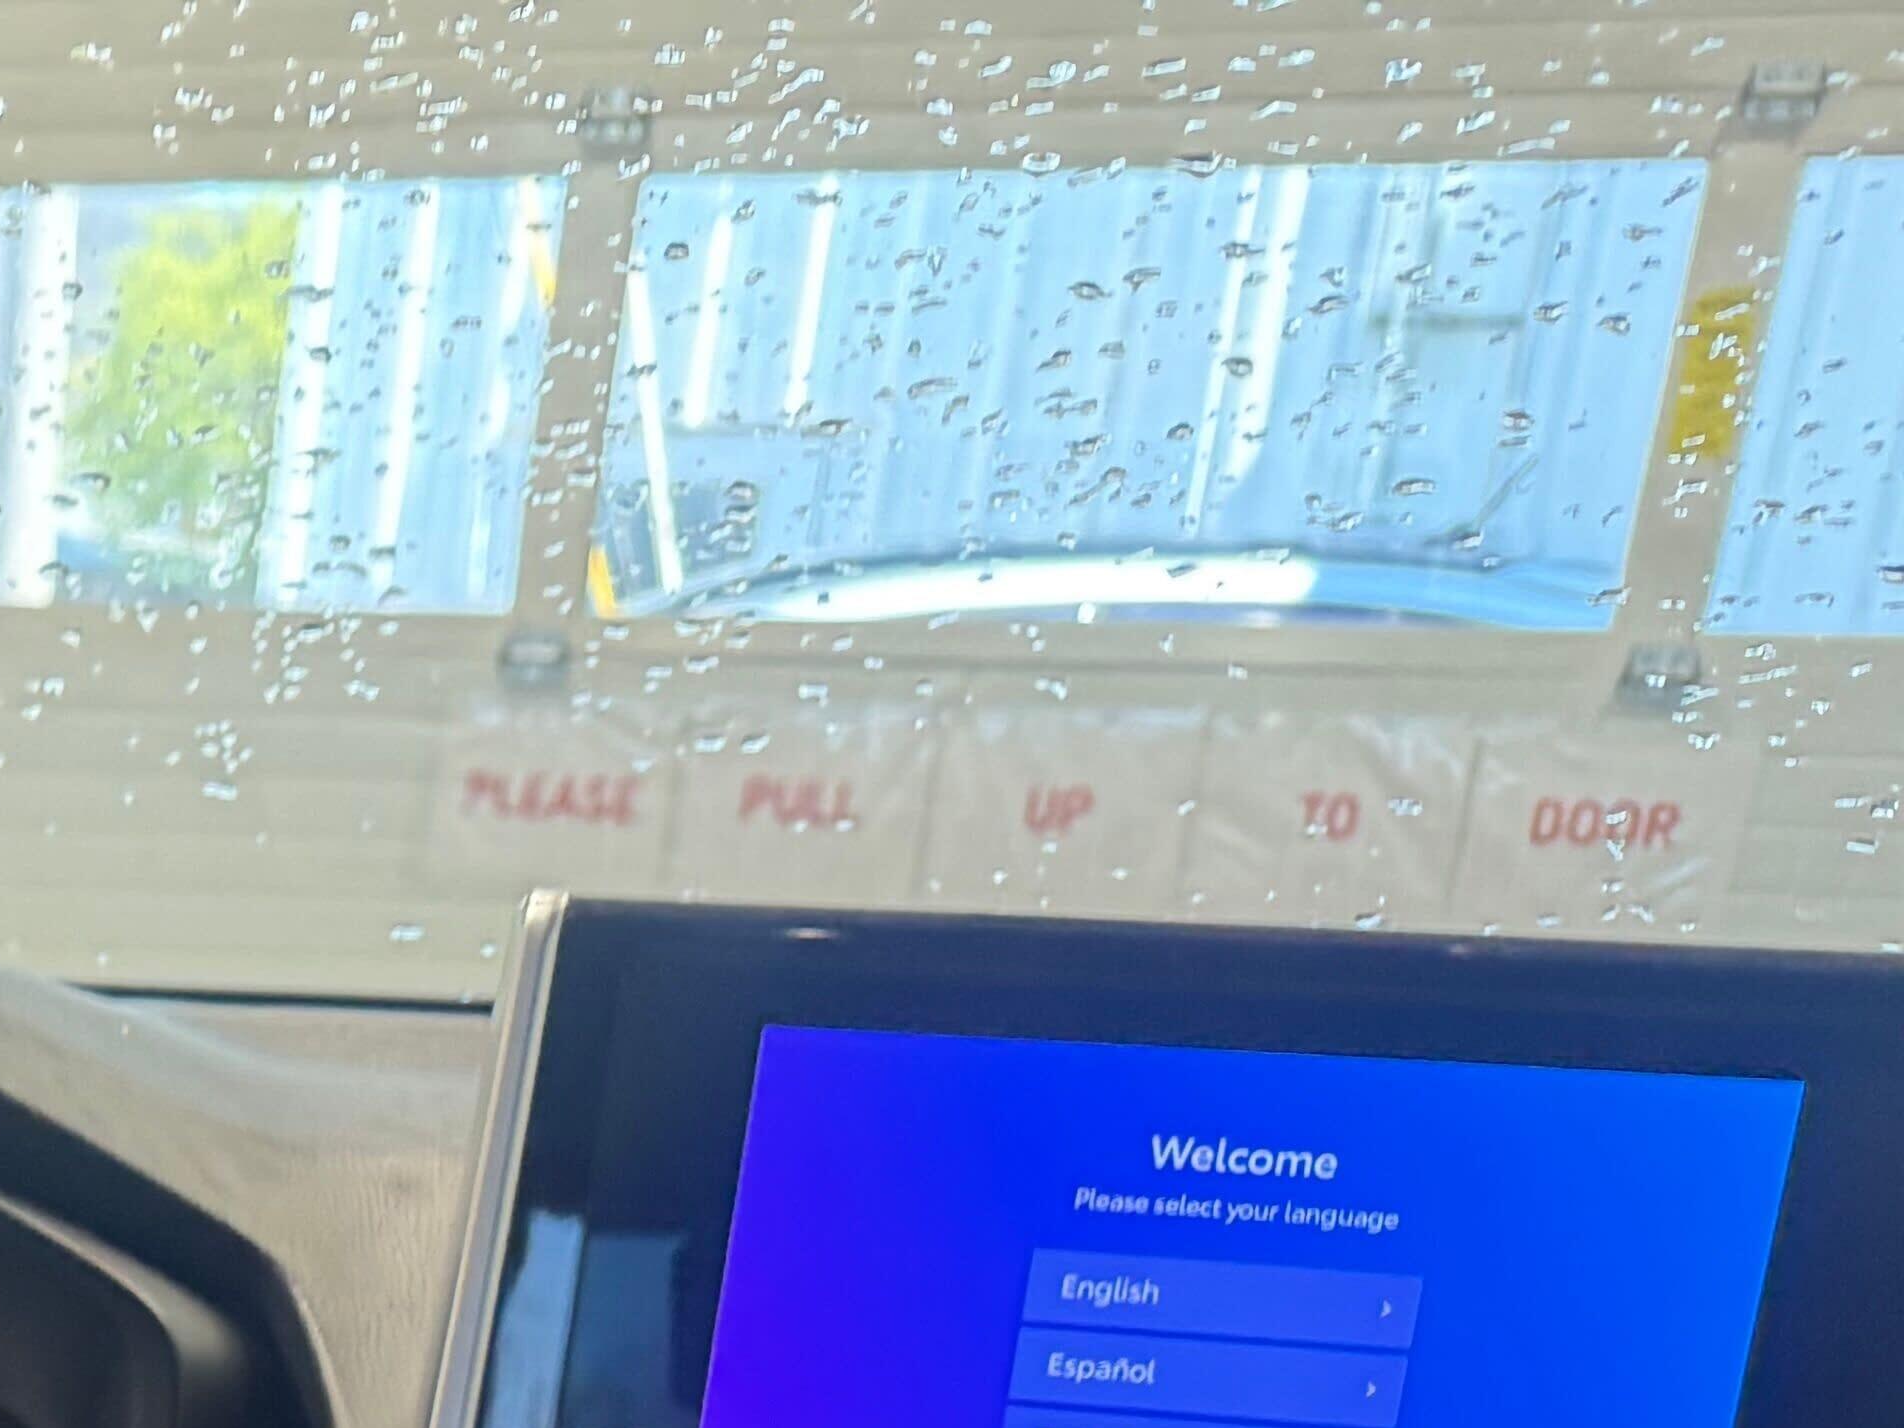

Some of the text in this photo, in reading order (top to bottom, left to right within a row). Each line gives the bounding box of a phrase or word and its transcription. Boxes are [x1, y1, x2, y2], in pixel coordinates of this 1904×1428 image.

[463, 768, 1684, 850] PLEASE PULL UP TO DOOR
[1152, 1134, 1338, 1181] Welcome
[1074, 1187, 1400, 1235] Please select your language
[1061, 1272, 1161, 1309] English
[1047, 1351, 1157, 1385] Español
